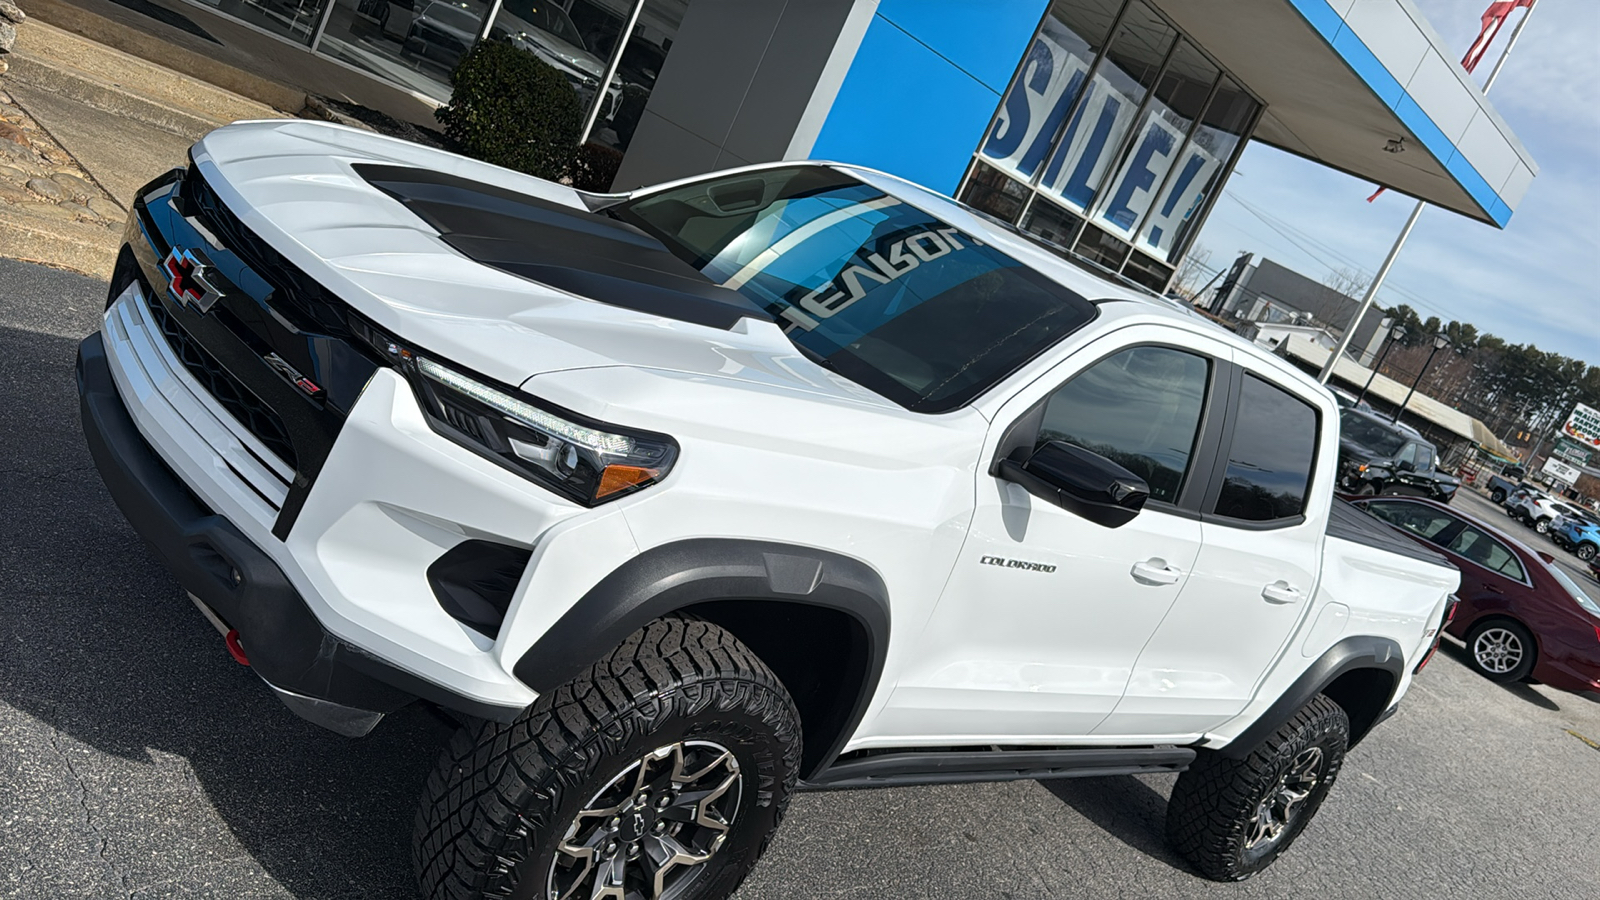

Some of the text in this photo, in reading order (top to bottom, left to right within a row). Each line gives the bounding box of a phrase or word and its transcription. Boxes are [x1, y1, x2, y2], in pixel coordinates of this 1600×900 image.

[981, 37, 1207, 249] SALE!
[263, 351, 321, 396] ZR2
[1573, 408, 1600, 427] HEALTH
[979, 554, 1057, 574] COLORADO
